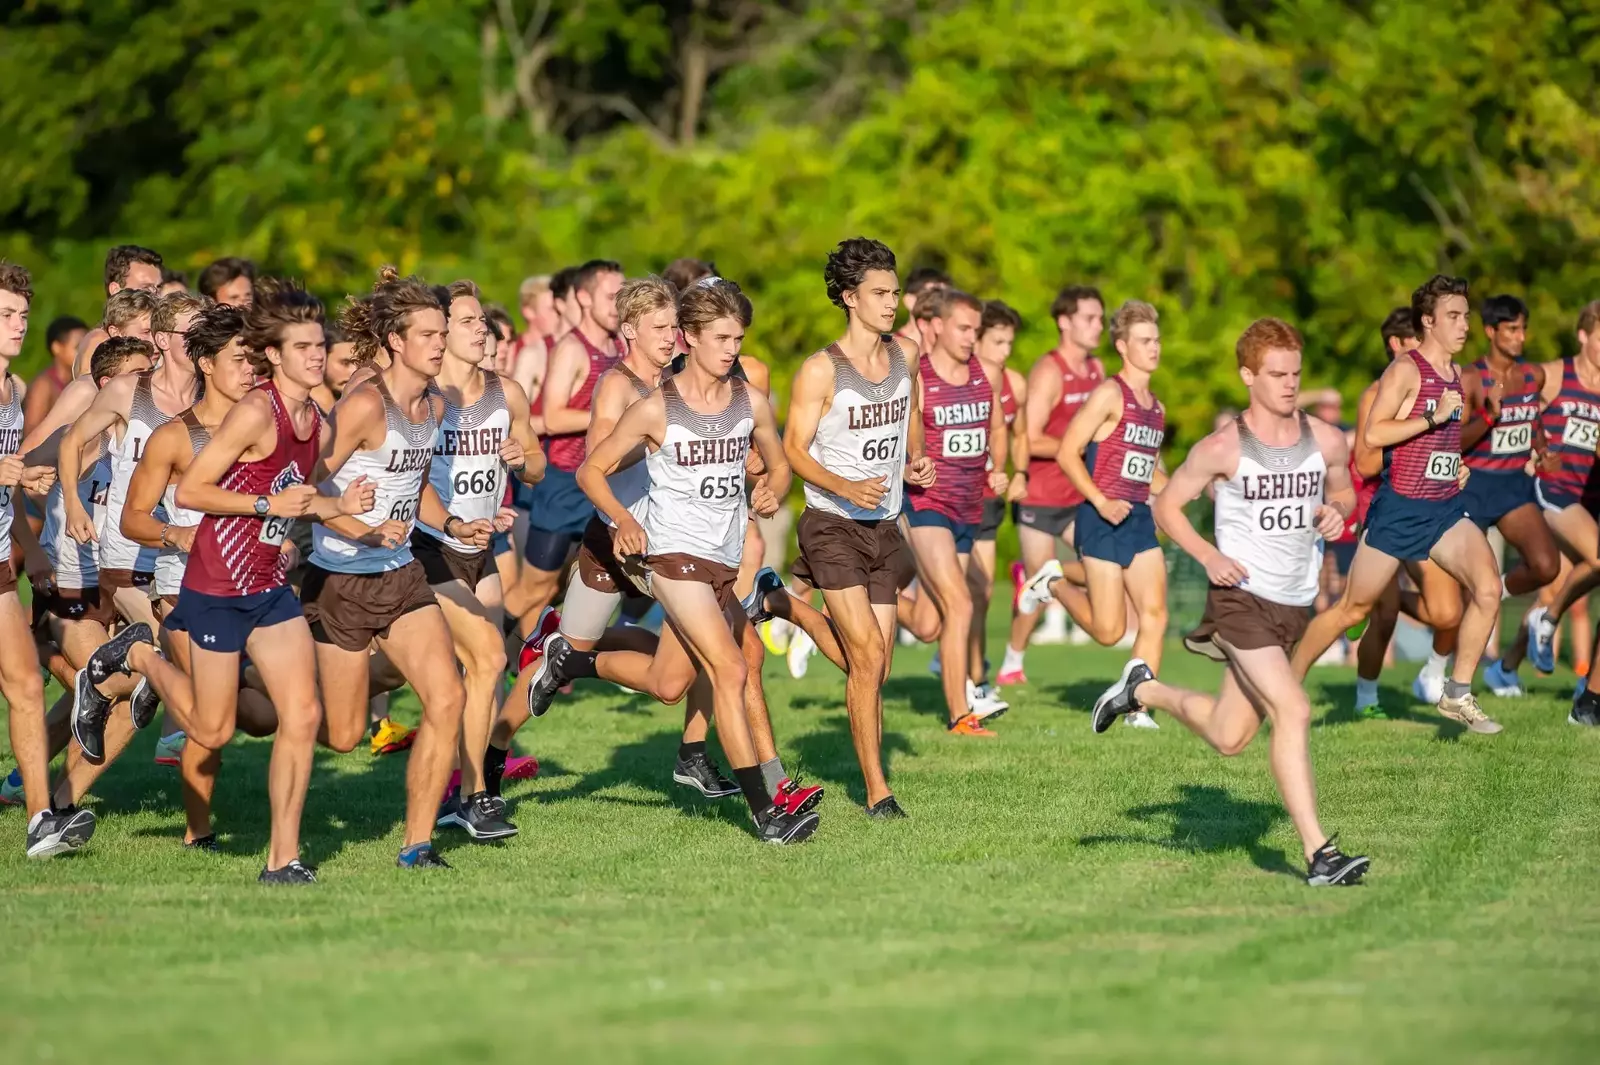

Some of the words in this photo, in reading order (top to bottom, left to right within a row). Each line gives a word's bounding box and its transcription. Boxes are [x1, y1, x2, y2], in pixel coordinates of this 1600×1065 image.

[848, 396, 908, 430] LEHIGH
[948, 433, 983, 453] 631
[1496, 427, 1529, 449] 760
[1569, 420, 1600, 446] 759
[384, 447, 434, 473] LEHIG
[674, 436, 747, 466] LEHIGH
[862, 436, 899, 461] 667
[1127, 456, 1154, 478] 637
[1431, 456, 1460, 477] 630
[454, 469, 496, 496] 668
[699, 475, 740, 499] 655
[1242, 471, 1321, 500] LEHIGH
[266, 516, 293, 541] 64
[1259, 505, 1307, 531] 661
